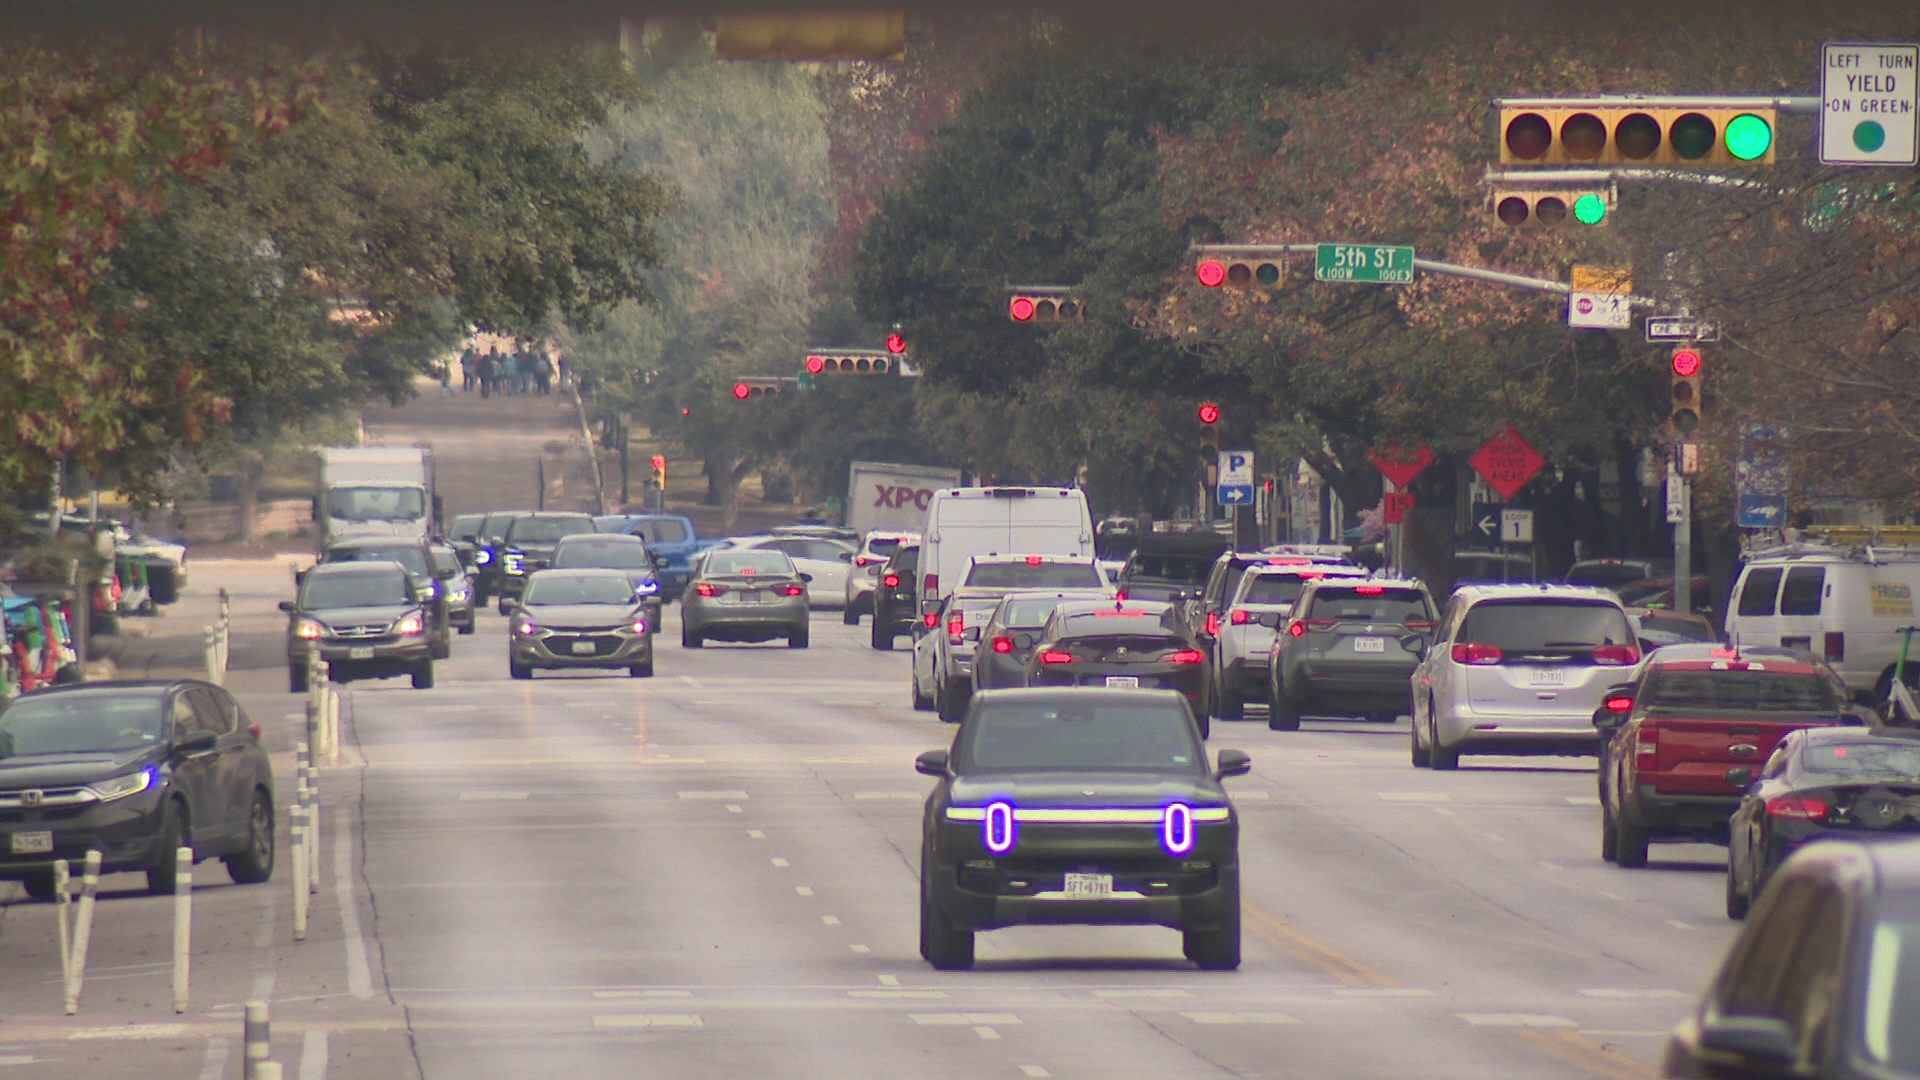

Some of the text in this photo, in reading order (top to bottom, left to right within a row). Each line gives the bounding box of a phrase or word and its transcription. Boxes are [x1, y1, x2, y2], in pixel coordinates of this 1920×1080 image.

[1829, 54, 1913, 68] LEFT TURN
[1847, 75, 1896, 92] YIELD
[1831, 98, 1909, 113] ON GREEN
[1334, 247, 1396, 268] 5th ST
[1654, 325, 1673, 334] ONE
[1230, 455, 1245, 472] P
[873, 484, 934, 512] XPO
[1505, 512, 1529, 520] LOOP
[1513, 522, 1520, 538] 1
